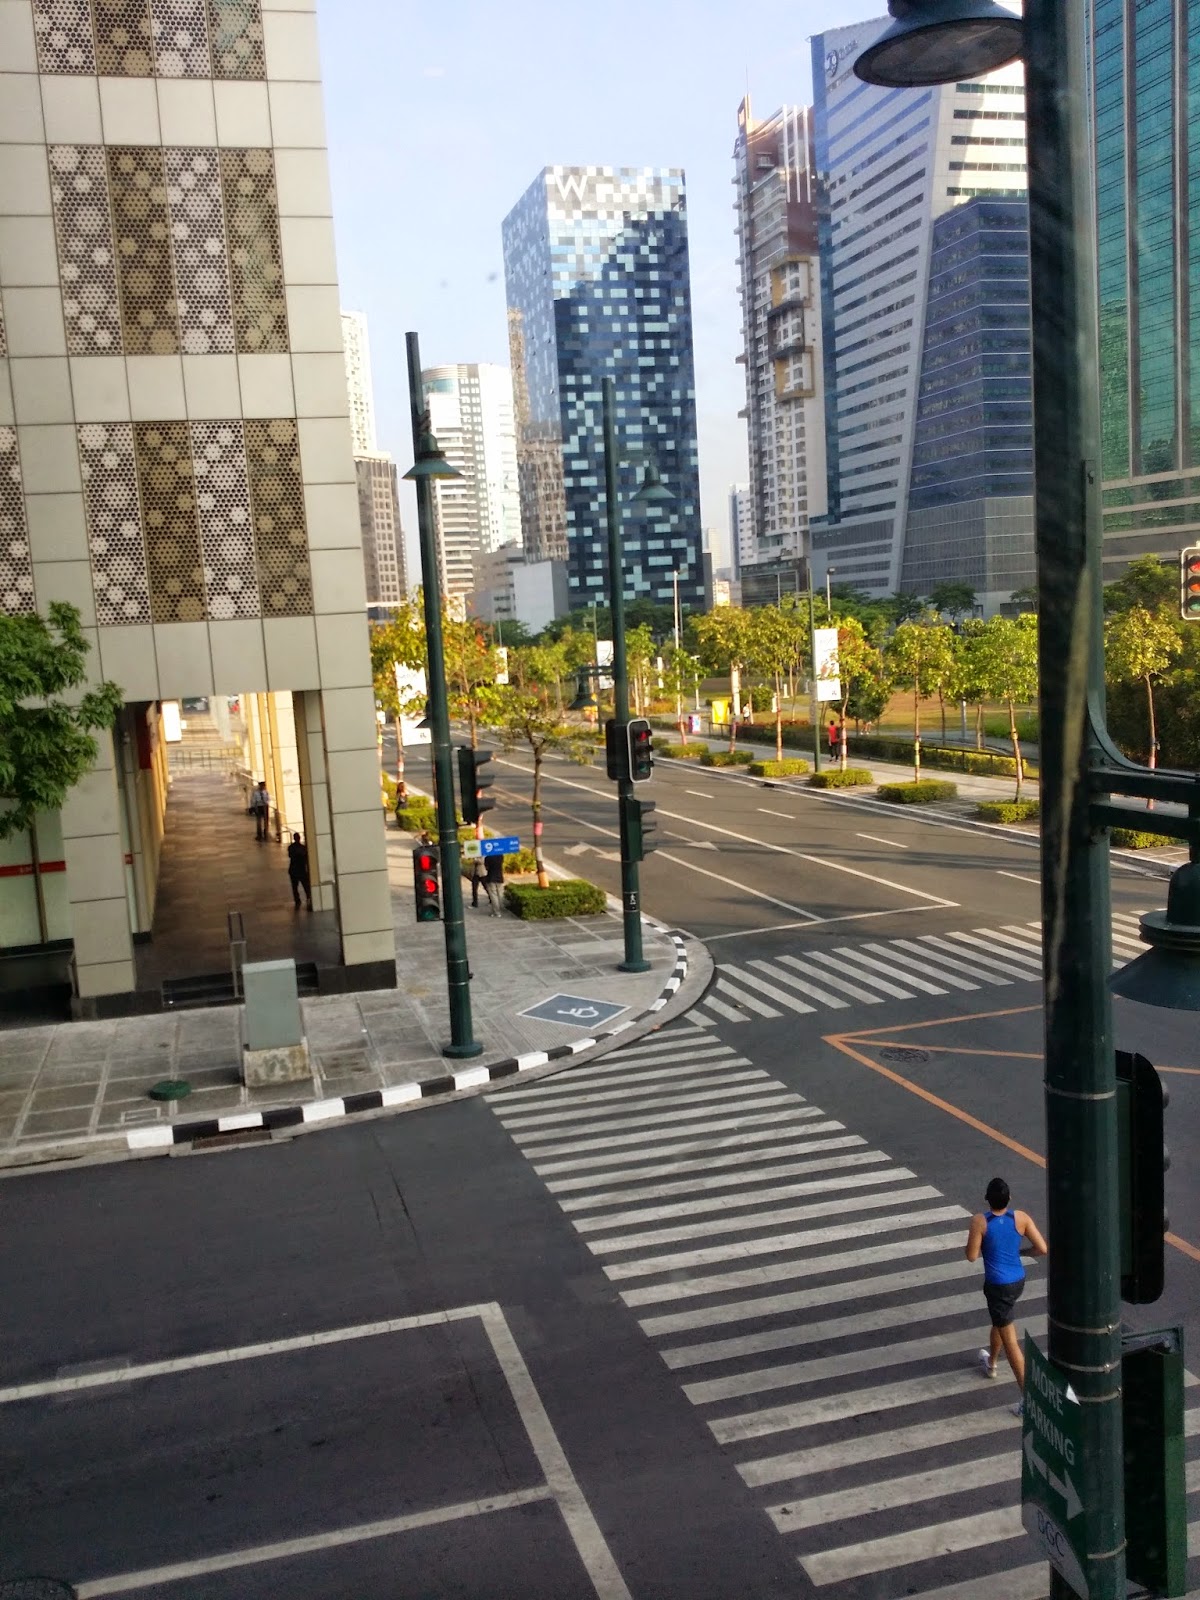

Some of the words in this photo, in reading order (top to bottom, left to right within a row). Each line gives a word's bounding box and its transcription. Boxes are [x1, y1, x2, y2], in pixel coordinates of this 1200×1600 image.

[554, 174, 588, 201] W
[1031, 1359, 1064, 1416] MORE
[1026, 1391, 1075, 1466] PARKING
[1037, 1510, 1065, 1557] BGC
